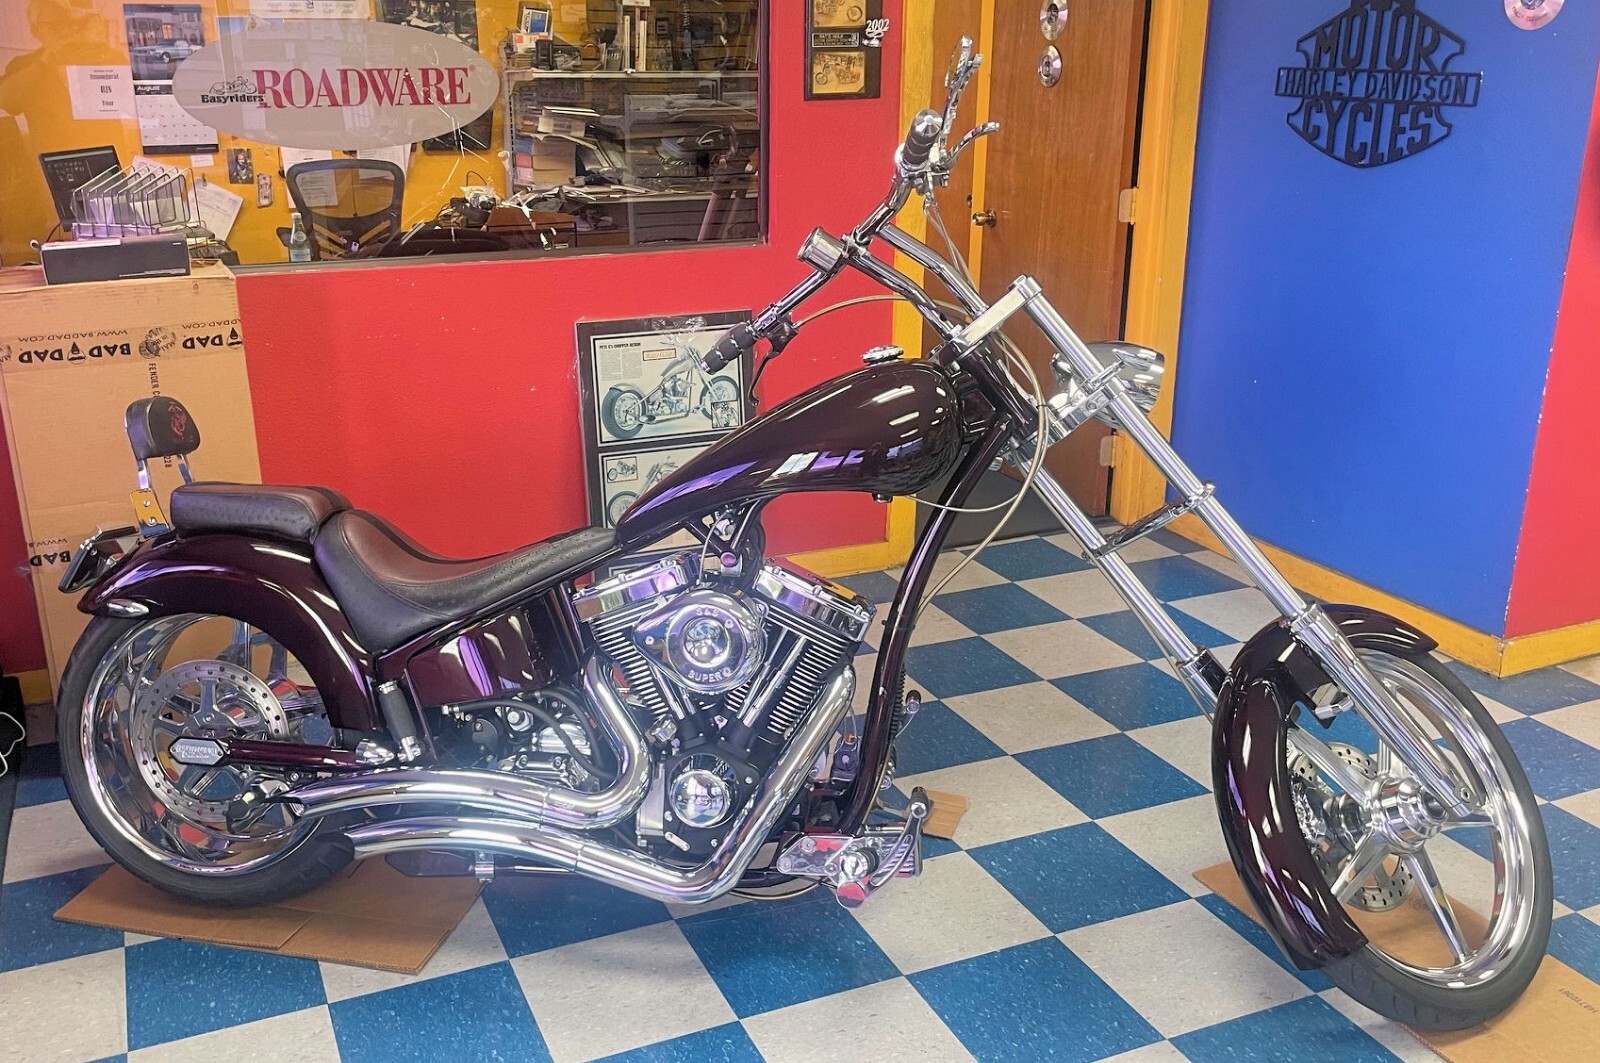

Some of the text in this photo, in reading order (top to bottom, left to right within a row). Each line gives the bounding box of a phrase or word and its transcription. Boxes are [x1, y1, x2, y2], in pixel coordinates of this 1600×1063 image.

[865, 19, 890, 32] 2002
[1313, 3, 1441, 71] MOTOR
[137, 85, 160, 93] August
[201, 67, 471, 108] Easyriders ROADWARE
[1284, 69, 1468, 103] HARLEY DAVIDSON
[1302, 98, 1435, 163] CYCLES
[17, 329, 128, 343] WWW.BADDAD.COM
[182, 334, 224, 349] DAD
[18, 348, 64, 364] DAD
[88, 343, 131, 358] BAD
[29, 550, 71, 567] BAD
